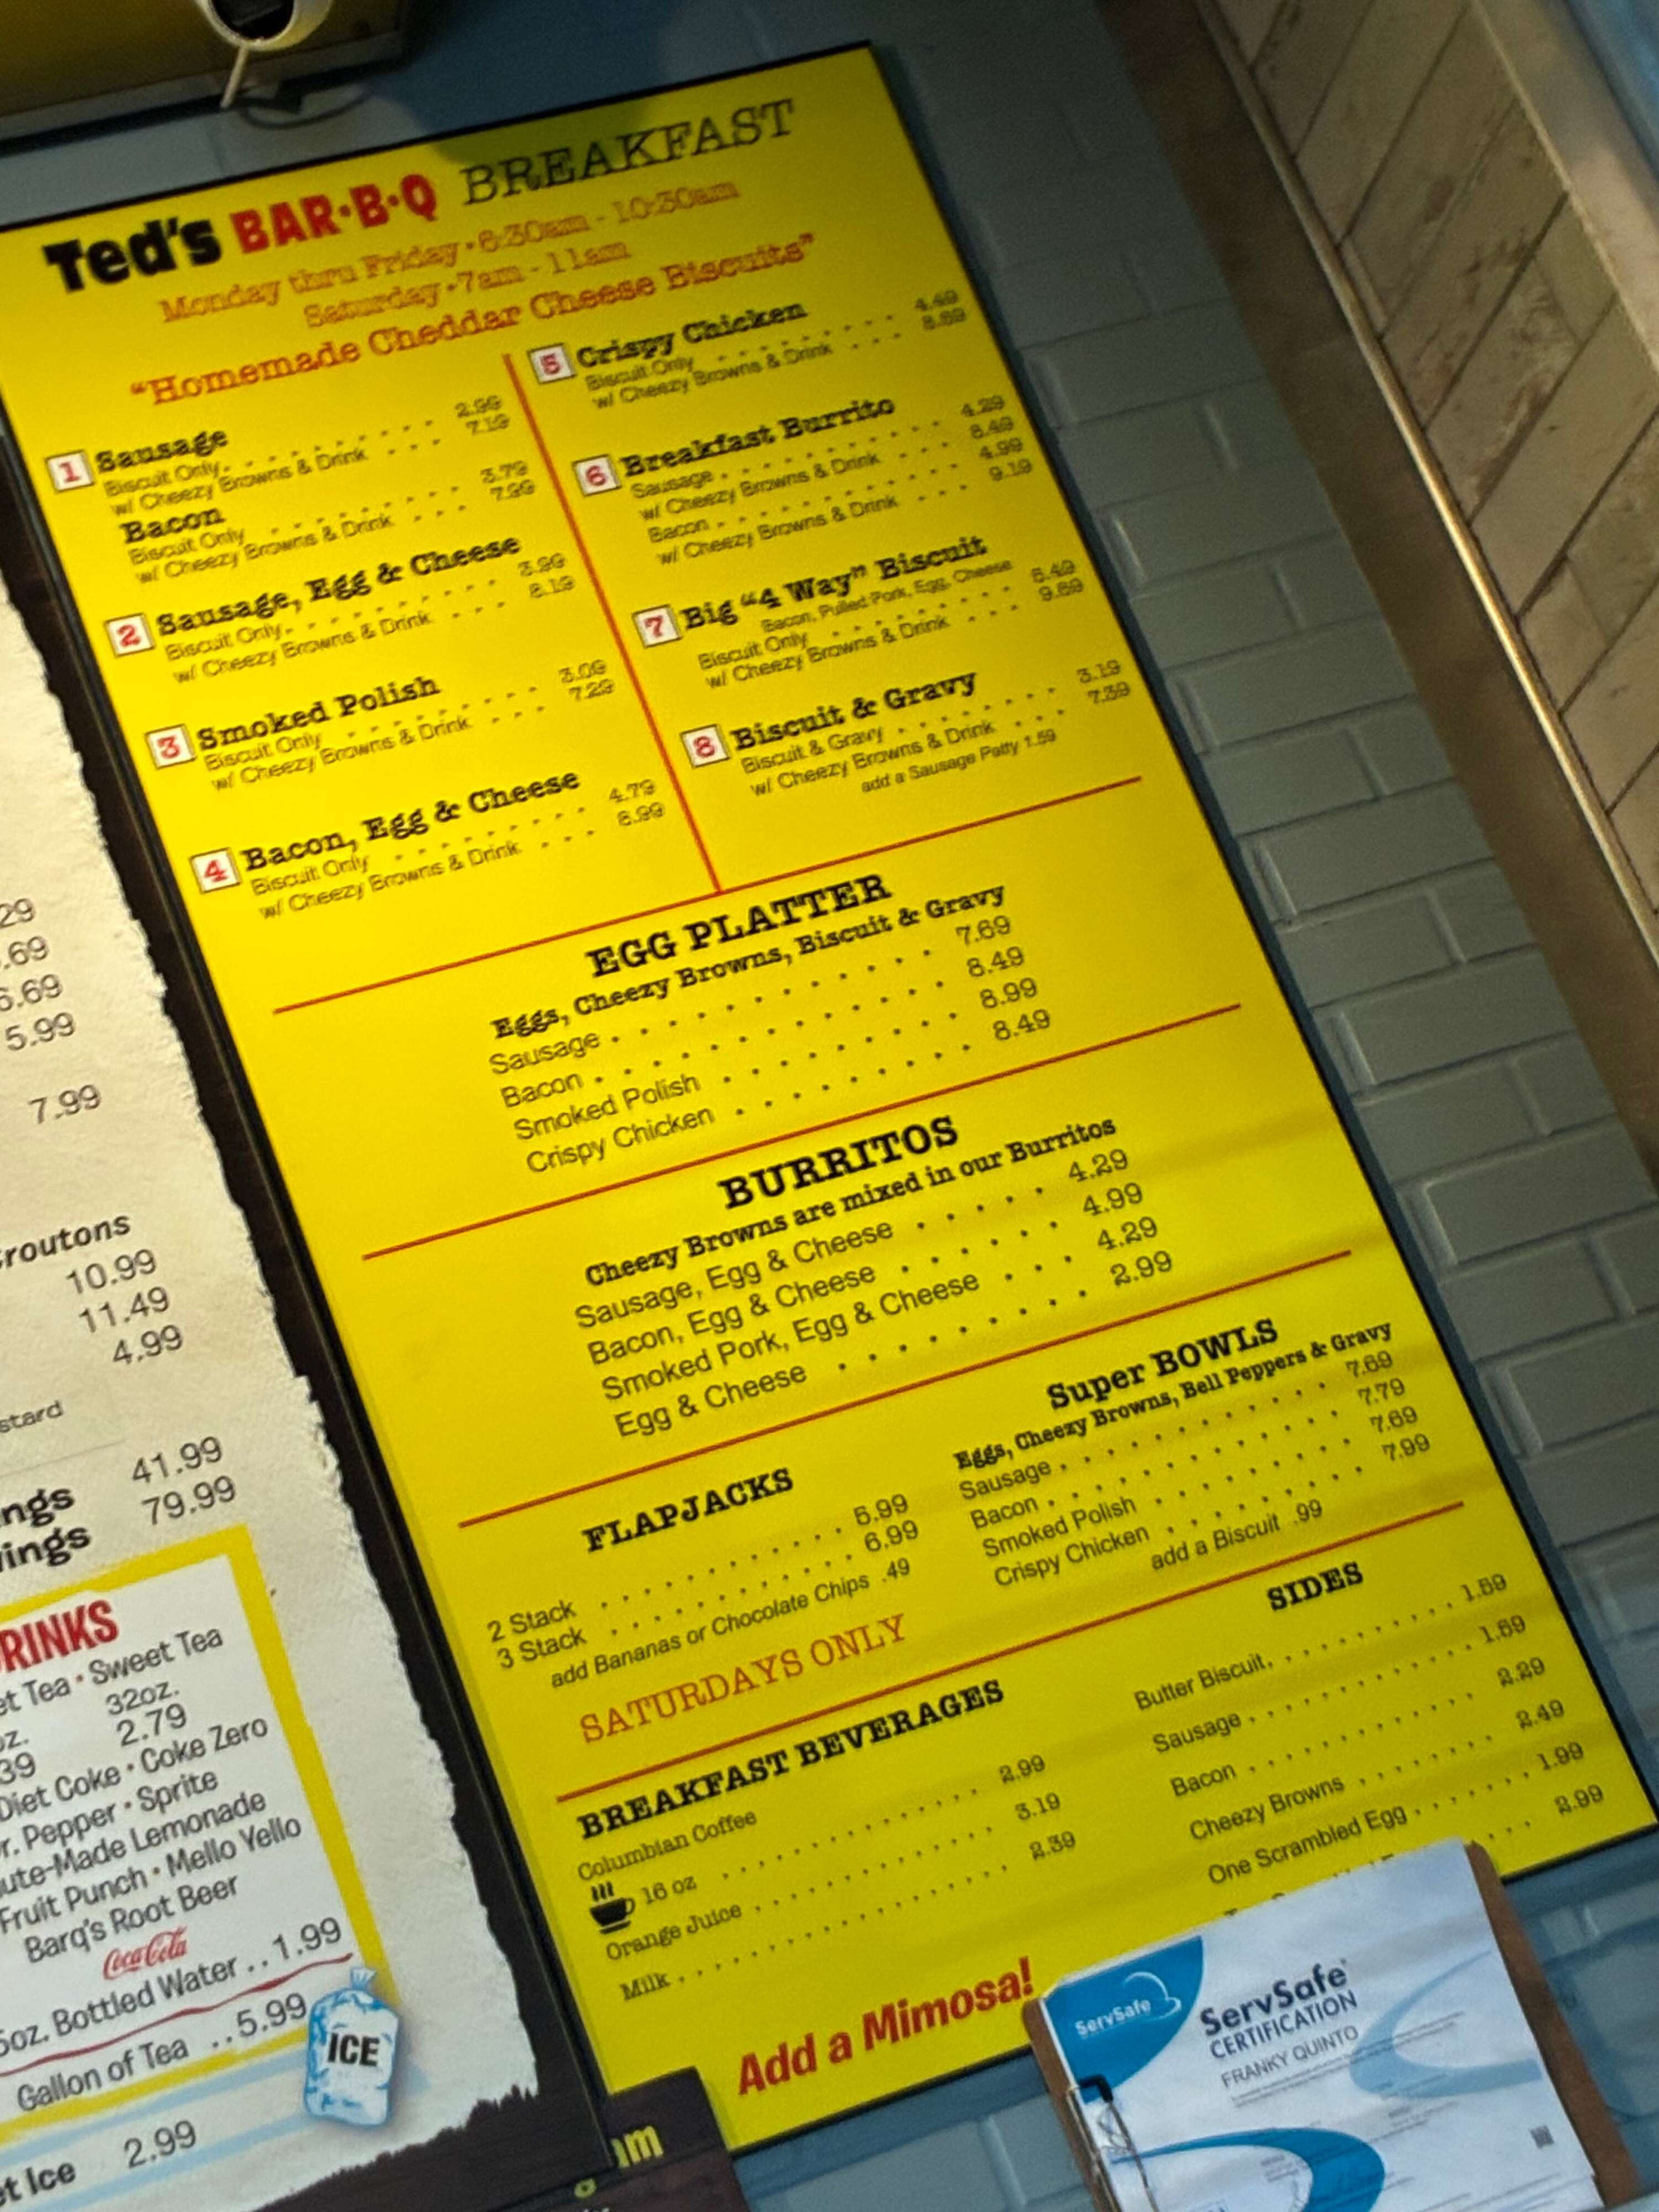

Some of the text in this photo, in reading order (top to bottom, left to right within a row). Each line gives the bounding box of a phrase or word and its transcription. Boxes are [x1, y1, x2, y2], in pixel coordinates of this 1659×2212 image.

[41, 216, 223, 293] Ted's
[460, 97, 795, 205] BREAKFAST
[158, 280, 282, 323] Monday
[287, 264, 360, 295] thru
[358, 240, 461, 280] Friday
[303, 241, 633, 329] Saturday 7am 11am
[367, 304, 524, 356] Cheddar
[529, 276, 657, 320] Cheese
[576, 303, 809, 369] Crispy Chicken
[94, 430, 229, 474] Sausage
[619, 398, 896, 478] Breakfast Burrito
[119, 508, 226, 545] Bacon
[156, 537, 522, 637] Sausage, Egg & Cheese
[679, 600, 739, 630] Big
[874, 535, 989, 581] Biscuit
[951, 559, 1015, 585] Cheese
[196, 675, 442, 751] Smoked Polish
[729, 672, 977, 751] Biscuit & Gravy
[861, 773, 891, 793] add
[894, 772, 905, 785] a
[908, 752, 977, 780] Sausage
[978, 740, 1020, 761] Patty
[240, 772, 581, 872] Bacon, Egg & Cheese
[490, 885, 1005, 1040] Eggs, Cheezy Browns, Biscuit & Gravy
[585, 873, 893, 978] EGG PLATTER
[488, 914, 1012, 1075] Sausage 7.69
[513, 977, 1039, 1141] Smoked Polish 8.99
[585, 1118, 1117, 1287] Cheezy Browns are mixed in our Burritos
[716, 1115, 959, 1210] BURRITOS
[0, 1215, 131, 1269] routons
[574, 1148, 1129, 1330] Sausage, Egg & Cheese 4.29
[112, 1324, 184, 1365] 4.99
[1046, 1317, 1279, 1411] Super BOWLS
[132, 1436, 223, 1484] 41.99
[581, 1467, 794, 1553] FLAPJACKS
[1151, 1540, 1190, 1572] add
[1194, 1539, 1209, 1557] a
[1212, 1513, 1281, 1552] Biscuit
[486, 1619, 506, 1644] 2
[509, 1600, 577, 1635] Stack
[1266, 1561, 1364, 1612] SIDES
[0, 1598, 119, 1673] RINKS
[21, 1628, 224, 1706] Tea Sweet Tea
[551, 1660, 589, 1689] add
[593, 1635, 682, 1676] Bananas
[686, 1625, 707, 1645] or
[711, 1593, 809, 1637] Chocolate
[813, 1574, 870, 1603] Chips
[105, 1681, 180, 1716] 32oz.
[579, 1612, 905, 1745] SATURDAYS ONLY
[1134, 1678, 1194, 1712] Butter
[115, 1702, 187, 1748] 2.79
[576, 1679, 1005, 1841] BREAKFAST BEVERAGES
[1169, 1656, 1546, 1798] Bacon 2.29
[0, 1718, 268, 1823] Diet Coke Coke Zero
[21, 1771, 219, 1851] Pepper Sprite
[129, 1791, 267, 1853] Lemonade
[577, 1810, 758, 1882] Columbian Coffee
[640, 1754, 1046, 1906] 16 oz 2.99
[1207, 1741, 1584, 1885] One Scrambled Egg 1.99
[0, 1817, 302, 1935] Fruit Punch Mello Yello
[23, 1875, 238, 1964] Barq's Root Beer
[605, 1925, 682, 1962] Orange
[685, 1904, 742, 1935] Juice
[51, 1916, 342, 2038] Bottled Water 1.99
[1075, 1997, 1152, 2037] ServSafe
[1199, 1959, 1347, 2037] ServSafe
[327, 2032, 380, 2068] ICE
[738, 1955, 1034, 2096] Add a Mimosa!
[1209, 1989, 1358, 2060] CERTIFICATION
[1220, 2025, 1367, 2089] FRANKY QUINTO
[25, 2119, 197, 2196] Ice 2.99
